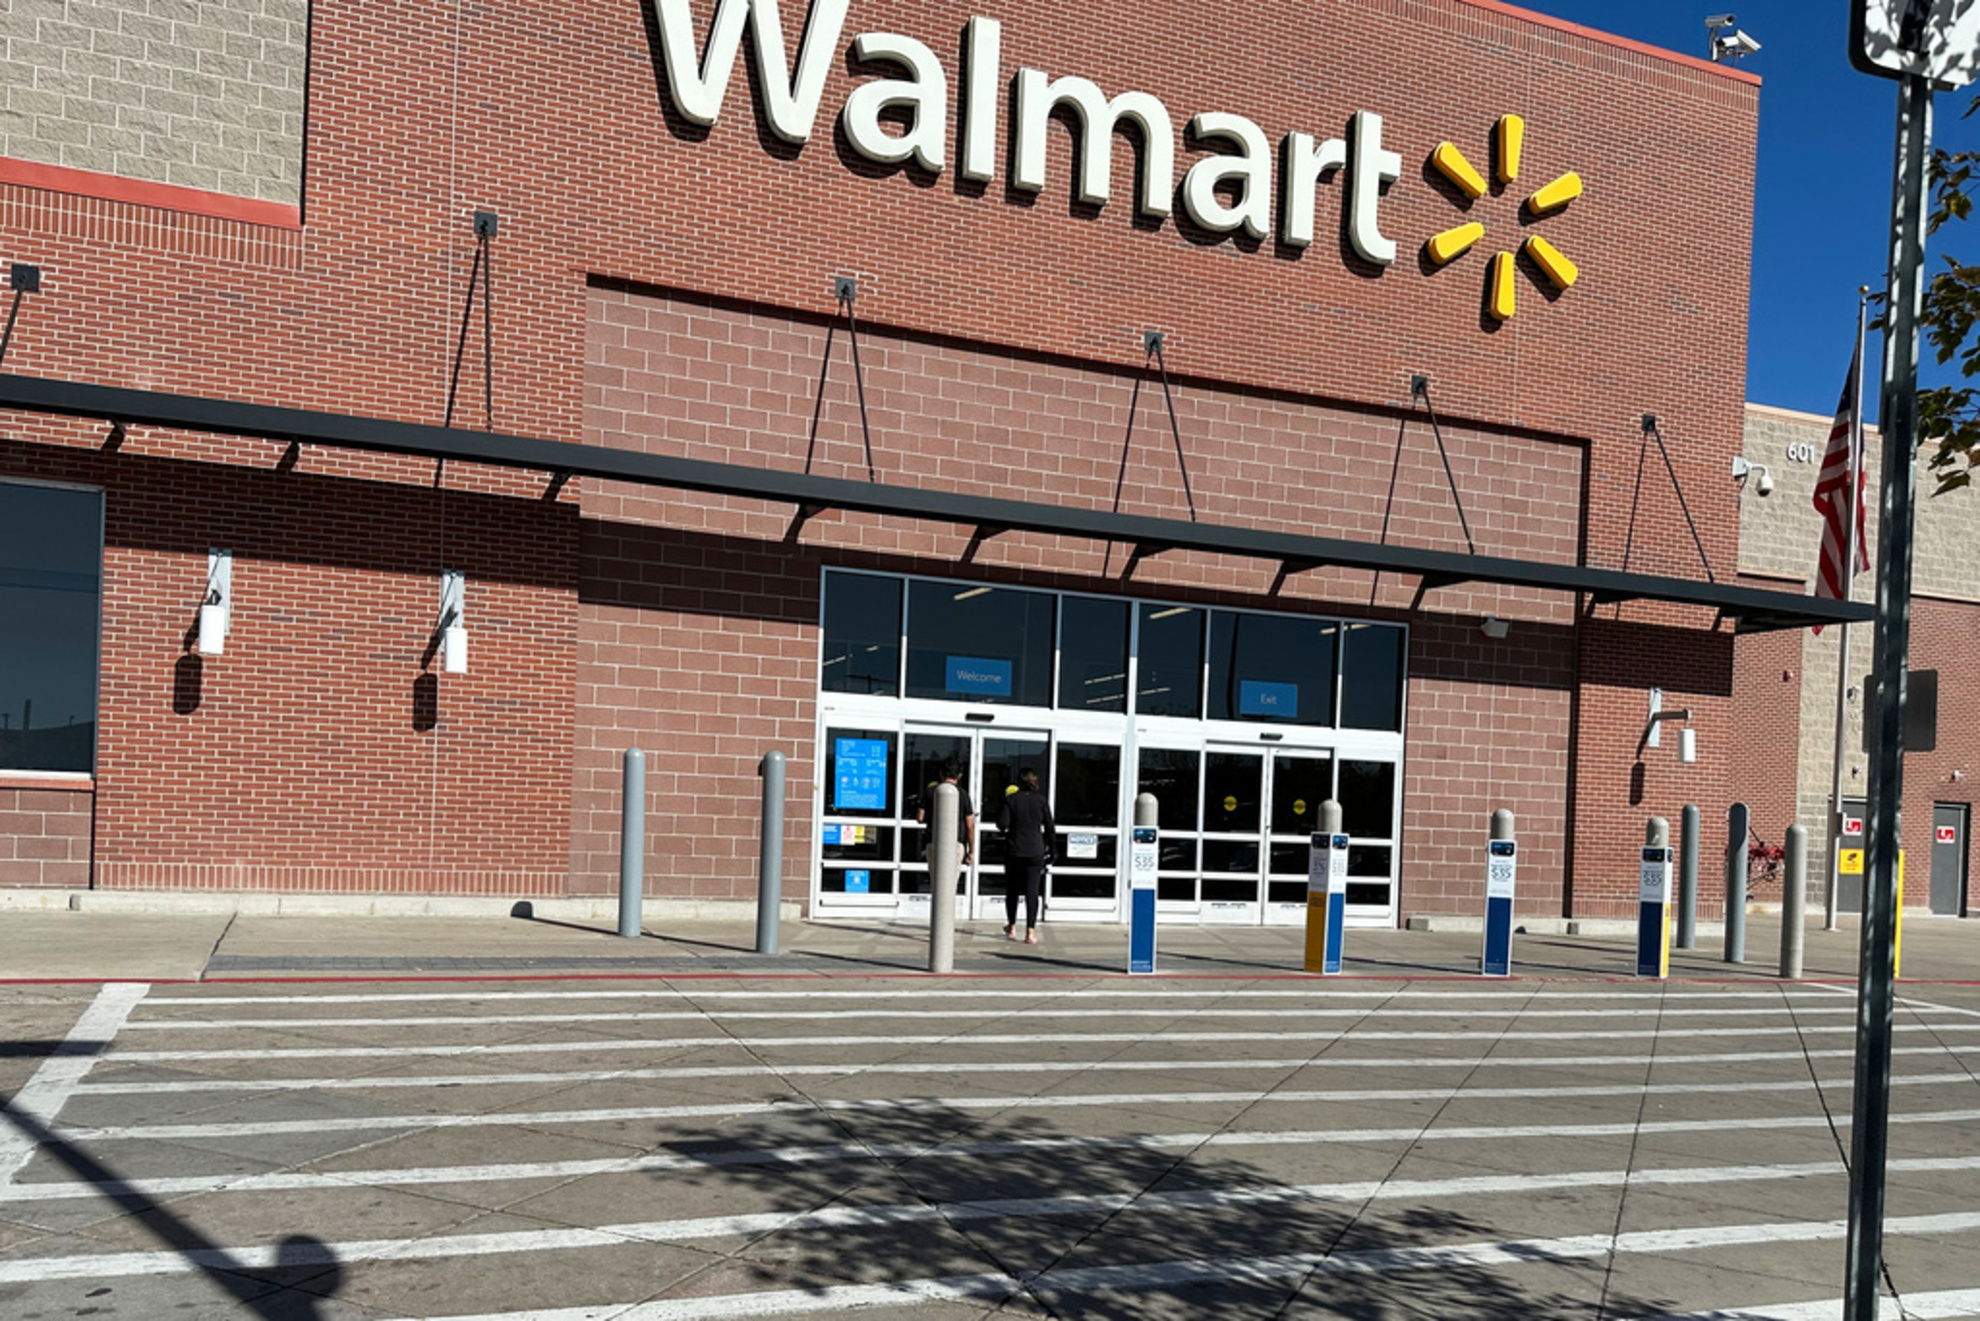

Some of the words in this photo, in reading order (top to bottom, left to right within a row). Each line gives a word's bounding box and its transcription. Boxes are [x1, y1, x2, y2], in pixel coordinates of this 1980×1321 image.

[648, 0, 1402, 265] Walmart
[1786, 441, 1816, 464] 601
[956, 669, 1002, 684] Welcome
[1260, 692, 1278, 705] Exit
